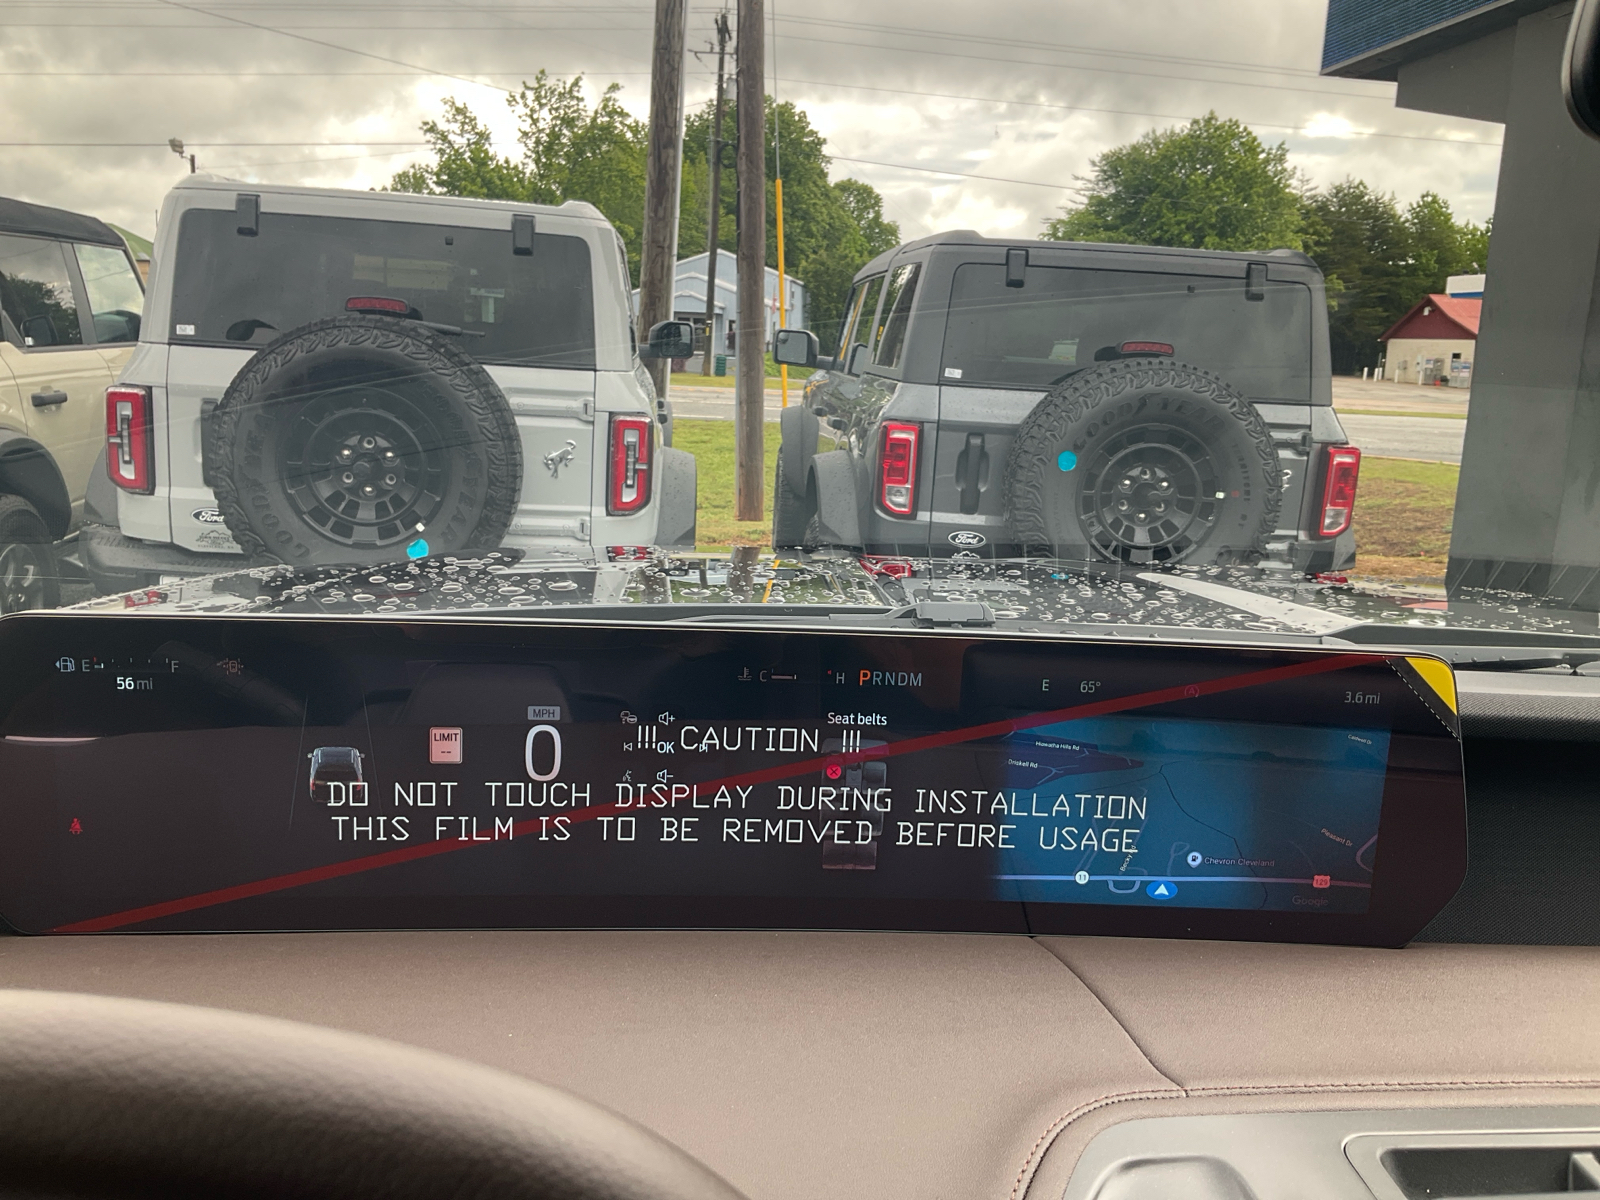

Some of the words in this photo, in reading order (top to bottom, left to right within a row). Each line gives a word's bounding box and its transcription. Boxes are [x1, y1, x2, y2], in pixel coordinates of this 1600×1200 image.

[82, 659, 90, 672] E
[171, 661, 179, 673] F
[836, 672, 845, 684] H
[1042, 679, 1050, 692] E
[532, 709, 555, 718] MPH
[827, 712, 854, 724] Seat
[857, 713, 888, 726] belts
[433, 732, 459, 742] LIMIT
[680, 726, 819, 752] CAUTION
[525, 724, 562, 781] 0
[657, 742, 674, 753] OK
[327, 781, 368, 806] DO
[395, 782, 457, 806] NOT
[485, 782, 590, 807] TOUCH
[615, 783, 753, 808] DISPLAY
[777, 785, 892, 811] DURING
[915, 789, 1147, 820] INSTALLATION
[331, 816, 410, 841] THIS
[436, 816, 513, 841] FILM
[539, 816, 571, 841] IS
[597, 816, 636, 841] TO
[660, 817, 699, 842] BE
[722, 818, 873, 844] REMOVED
[896, 821, 1017, 849] BEFORE
[1039, 826, 1139, 853] USAGE
[1119, 854, 1133, 872] Becky
[1204, 857, 1236, 866] Chevron
[1238, 858, 1275, 867] Cleveland
[1315, 878, 1328, 886] 129
[1292, 895, 1328, 906] Google
